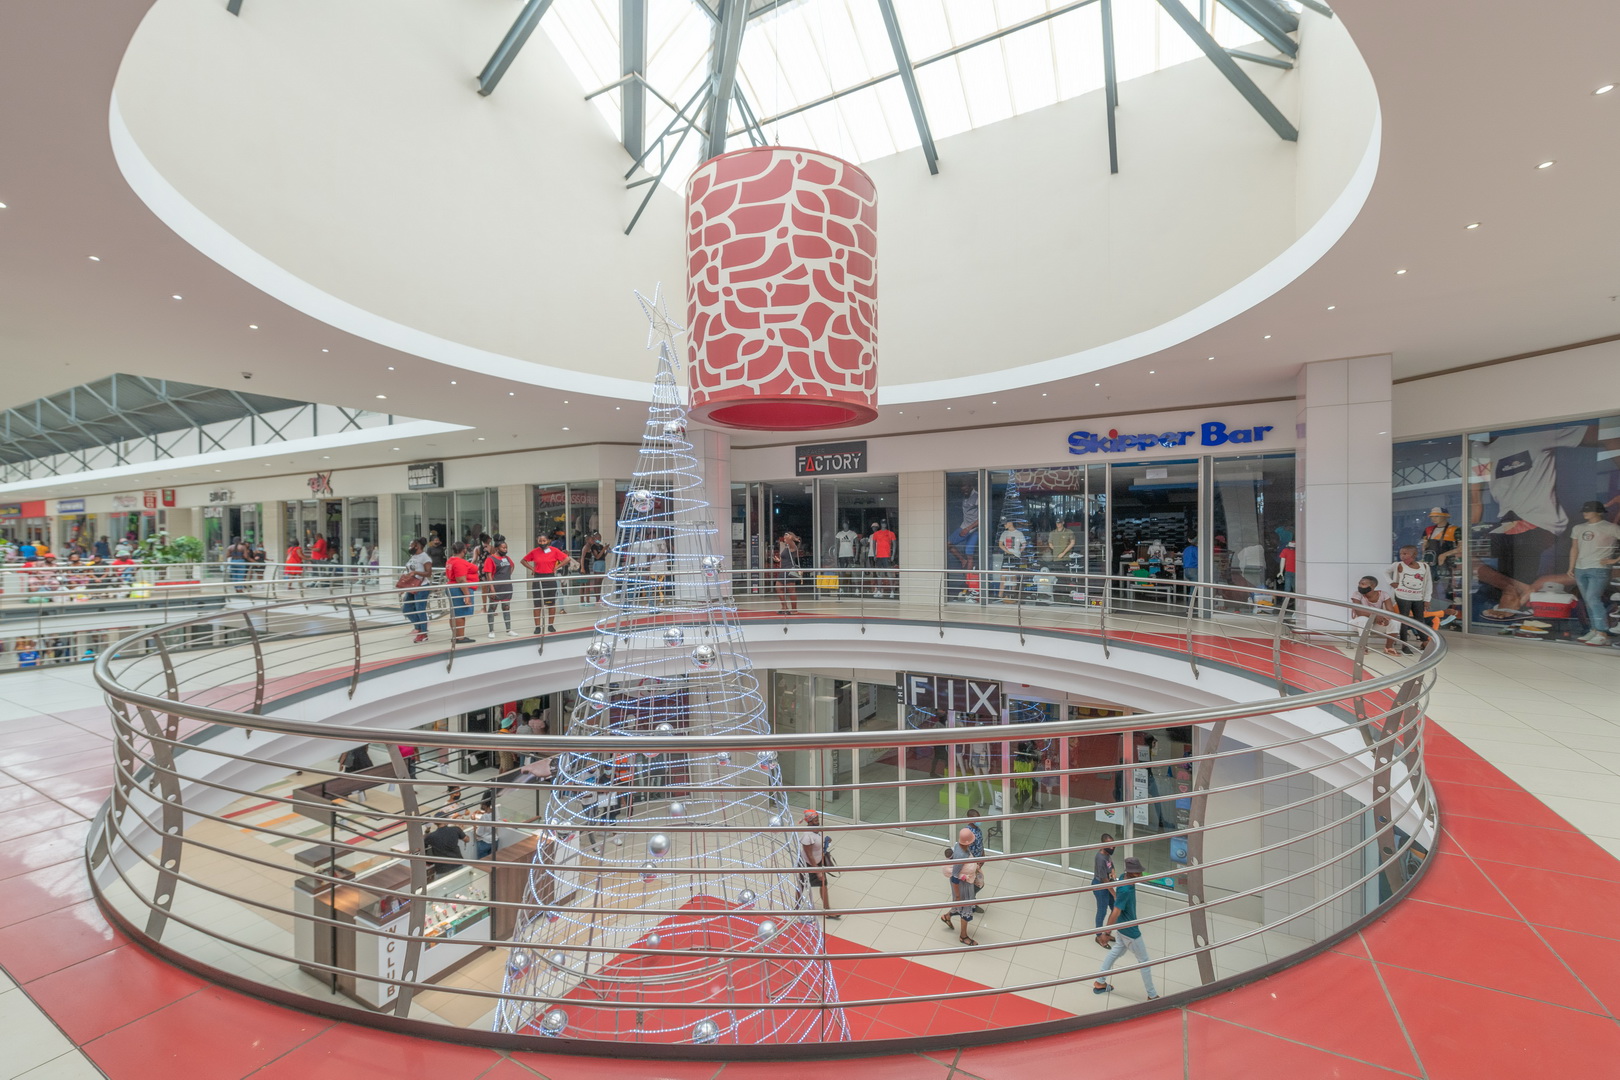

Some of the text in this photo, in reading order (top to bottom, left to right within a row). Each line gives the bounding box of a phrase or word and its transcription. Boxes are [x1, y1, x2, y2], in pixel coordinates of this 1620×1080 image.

[1068, 421, 1274, 455] Skipper Bar
[798, 452, 861, 473] FACTORY
[910, 676, 998, 716] FIX
